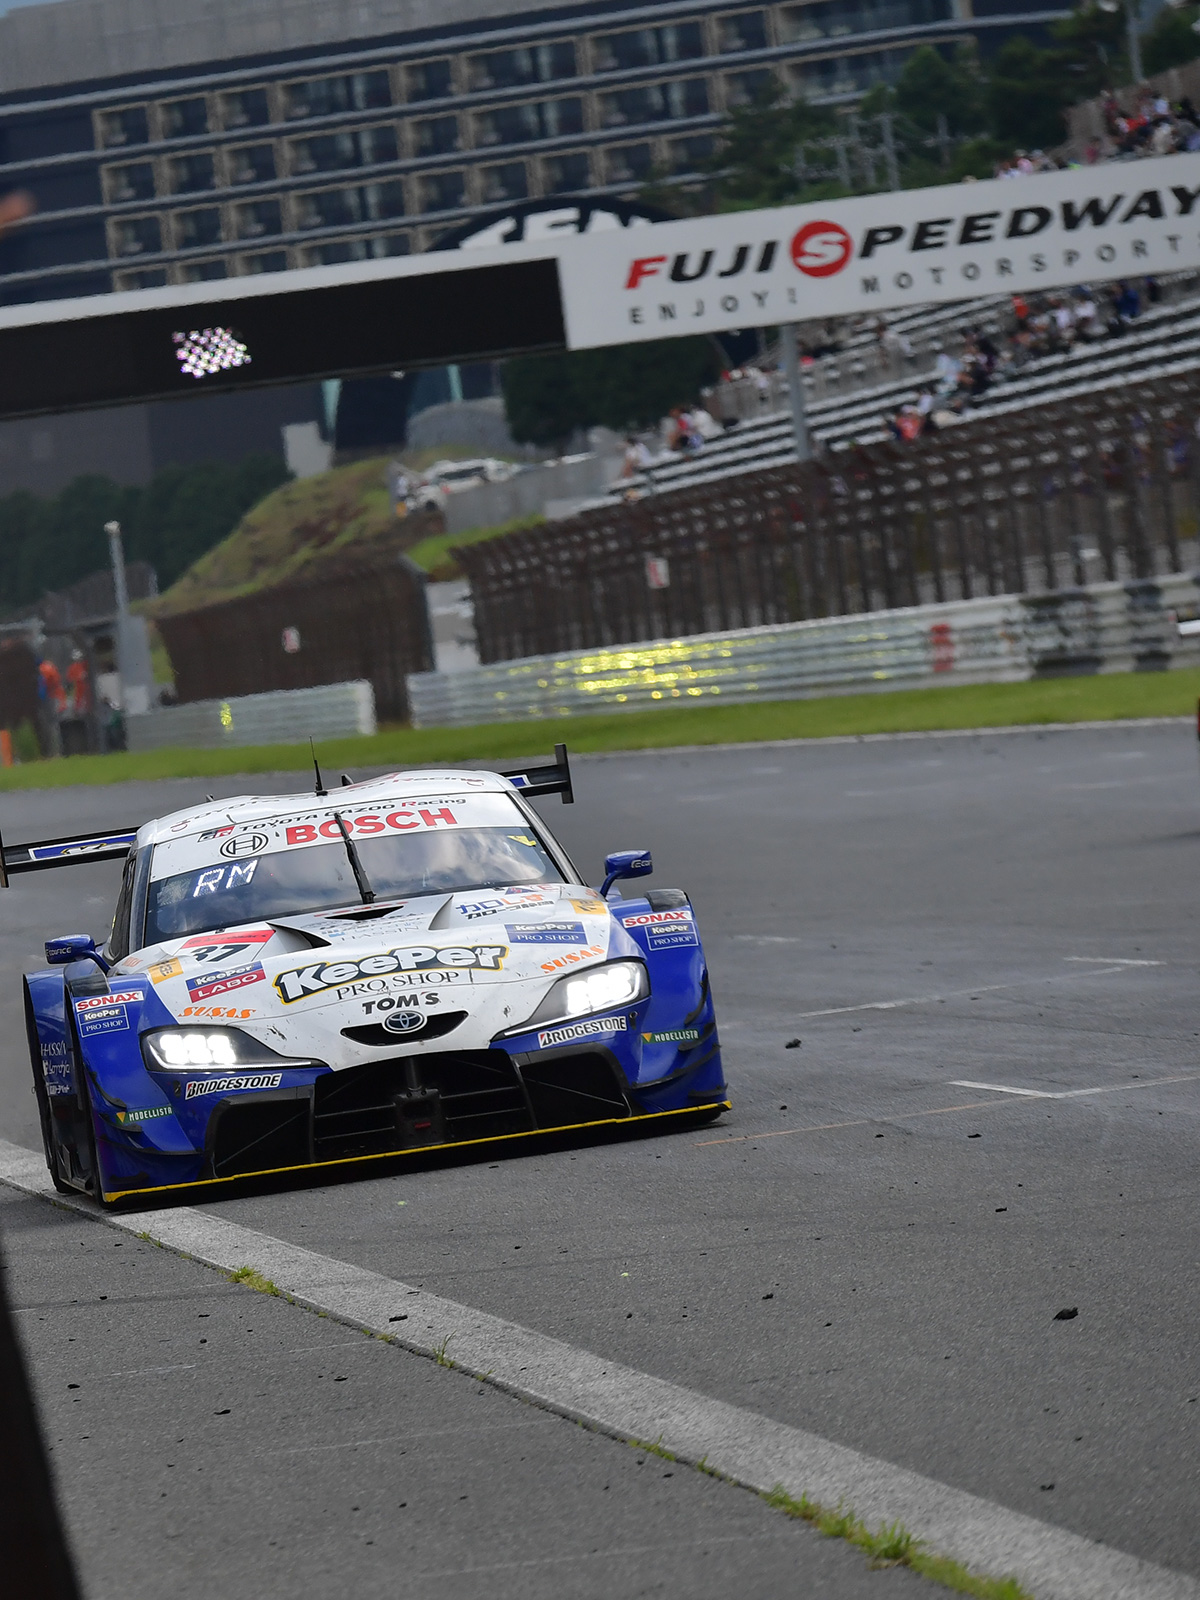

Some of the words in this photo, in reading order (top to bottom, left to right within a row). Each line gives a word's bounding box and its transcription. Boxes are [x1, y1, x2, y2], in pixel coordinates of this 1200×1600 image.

[625, 240, 780, 290] FUJI
[790, 184, 1200, 276] SPEEDWAY
[629, 288, 798, 325] ENJOY!
[860, 233, 1200, 295] MOTORSPORT
[240, 812, 317, 831] TOYOTA
[324, 803, 395, 817] GAZOO
[401, 798, 467, 808] Racing
[286, 808, 458, 846] BOSCH
[193, 859, 259, 898] RM
[624, 911, 689, 926] SONAX
[651, 924, 689, 935] KeePer
[654, 937, 669, 945] PRO
[670, 935, 693, 944] SHOP
[191, 944, 251, 962] 37
[540, 944, 605, 973] SUSAS
[195, 965, 253, 986] KeePer
[277, 946, 503, 1002] KeePer
[198, 974, 258, 998] LABO
[335, 979, 386, 1000] PRO
[393, 971, 459, 987] SHOP
[76, 992, 139, 1010] SONAX
[84, 1008, 120, 1021] KeePer
[178, 1007, 256, 1018] SUSAS
[86, 1022, 101, 1031] PRO
[102, 1020, 123, 1029] SHOP
[540, 1017, 626, 1047] BRIDGESTONE
[654, 1030, 699, 1042] MODELLISTA
[186, 1074, 281, 1099] BRIDGESTONE
[129, 1107, 173, 1122] MODELLISTA
